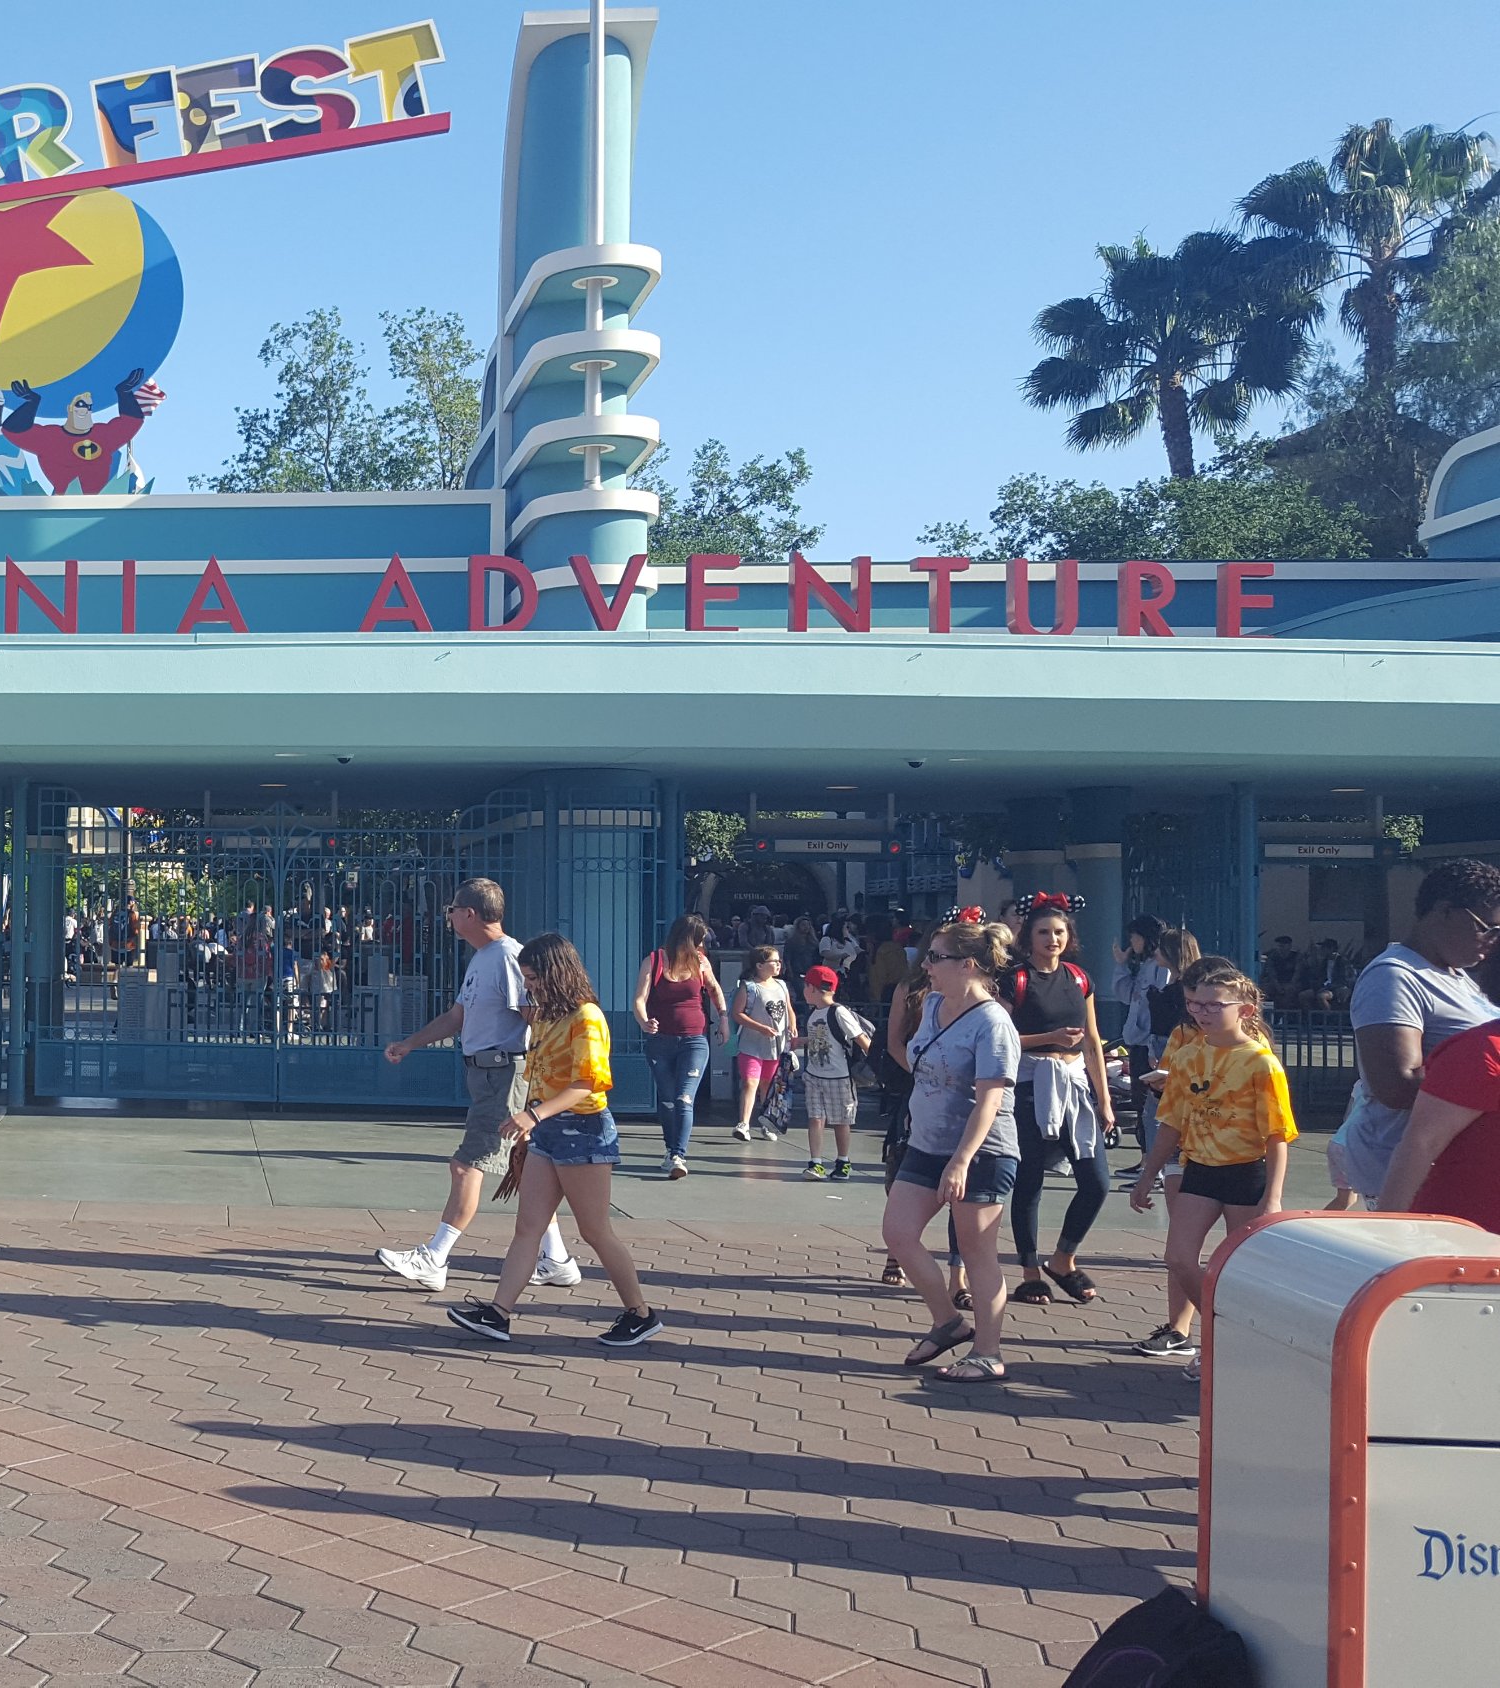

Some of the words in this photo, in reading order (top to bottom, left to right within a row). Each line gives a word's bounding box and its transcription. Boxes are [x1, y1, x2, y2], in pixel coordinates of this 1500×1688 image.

[90, 19, 445, 168] FEST
[360, 551, 1277, 639] ADVENTURE
[807, 841, 823, 850] Exit
[827, 841, 849, 852] Only
[1298, 846, 1315, 854] Exit
[1317, 846, 1340, 856] Only
